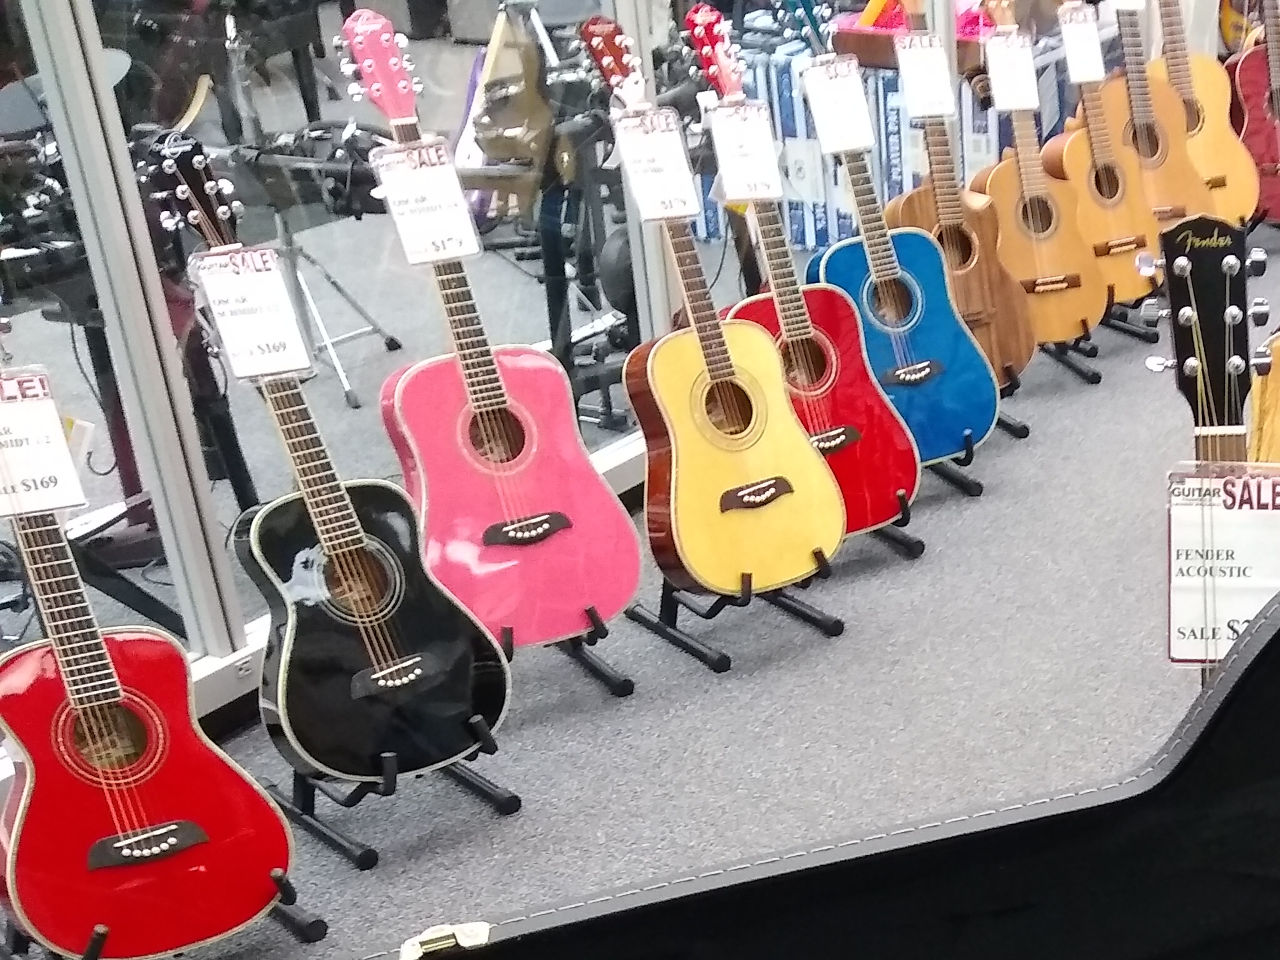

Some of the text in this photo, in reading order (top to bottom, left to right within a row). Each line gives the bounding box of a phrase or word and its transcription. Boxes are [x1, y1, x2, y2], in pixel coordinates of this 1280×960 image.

[1175, 226, 1233, 254] Fender
[0, 376, 50, 400] LE!
[20, 474, 58, 493] $169
[1171, 486, 1221, 498] GUITAR
[1175, 549, 1236, 561] FENDER
[1175, 565, 1253, 578] ACOUSTIC
[1176, 626, 1222, 641] SALE
